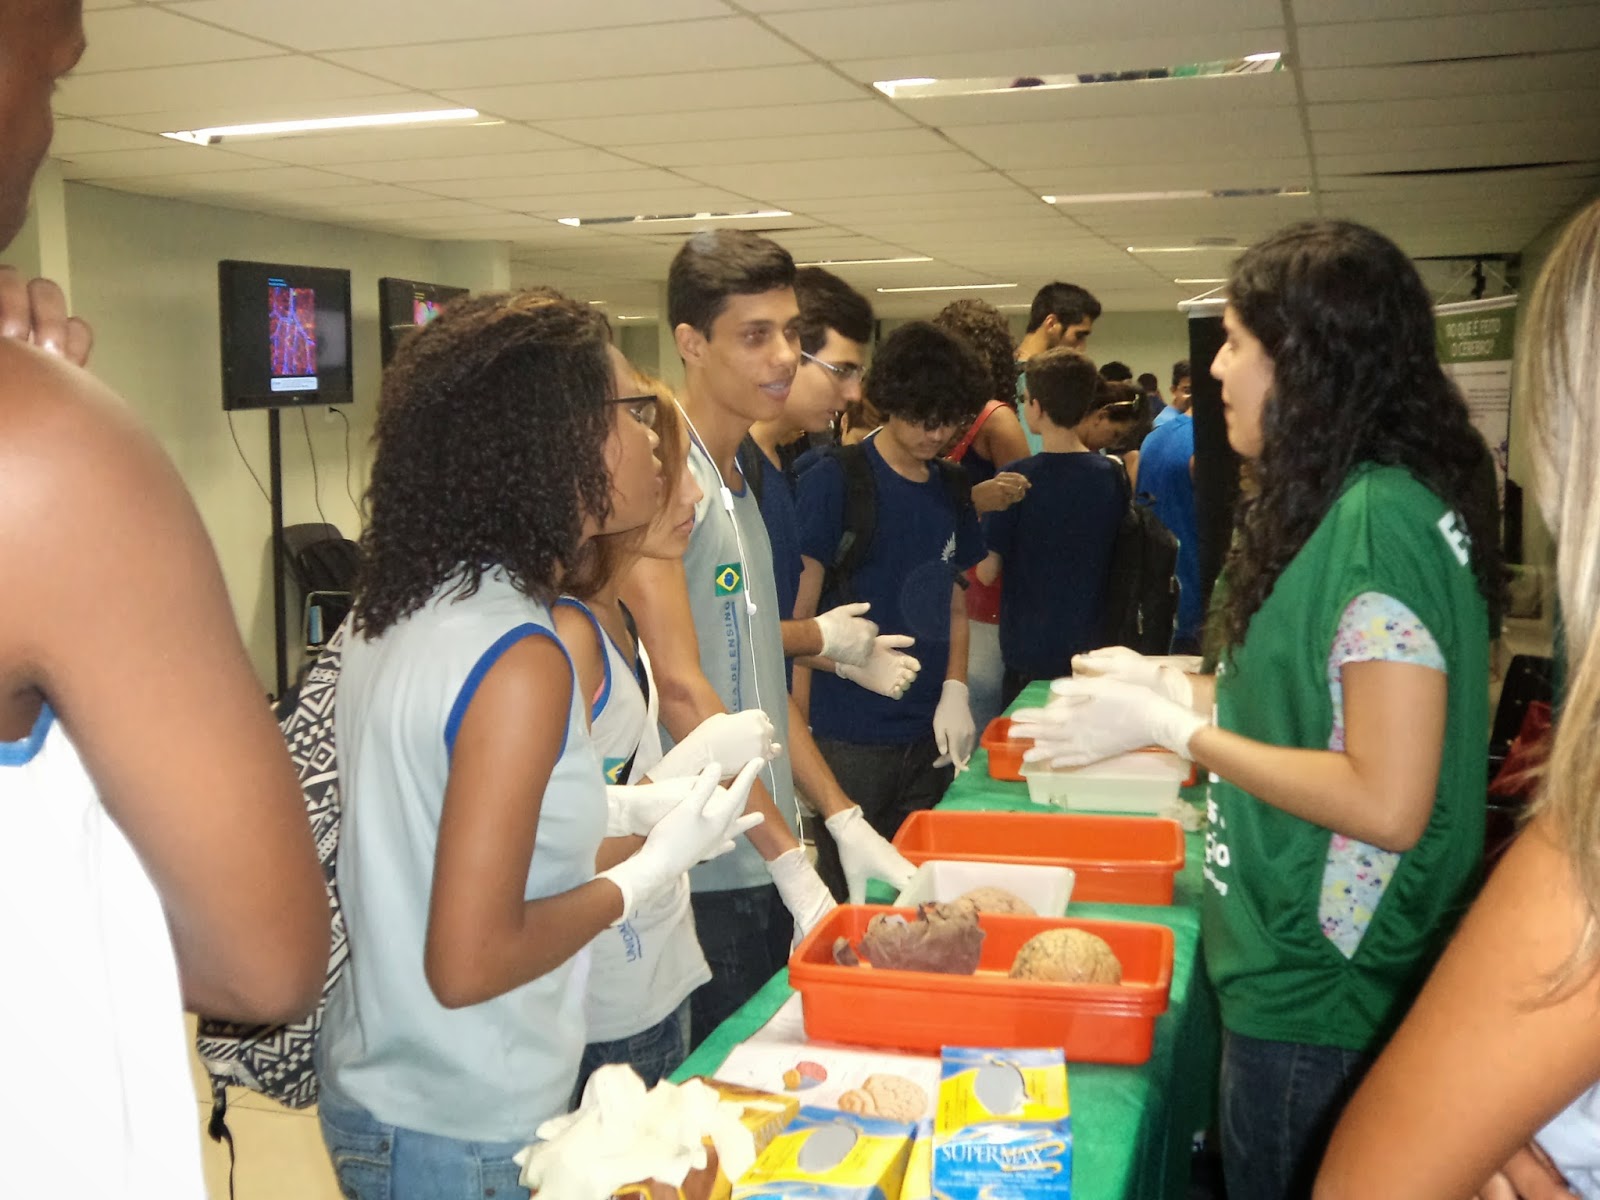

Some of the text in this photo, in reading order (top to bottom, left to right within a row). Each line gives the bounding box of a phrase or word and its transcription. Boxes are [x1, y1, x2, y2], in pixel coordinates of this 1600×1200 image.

[1457, 321, 1472, 339] QUE
[1480, 318, 1501, 334] FEITO
[723, 601, 736, 658] ENSINO
[941, 1143, 1043, 1166] SUPERMAX
